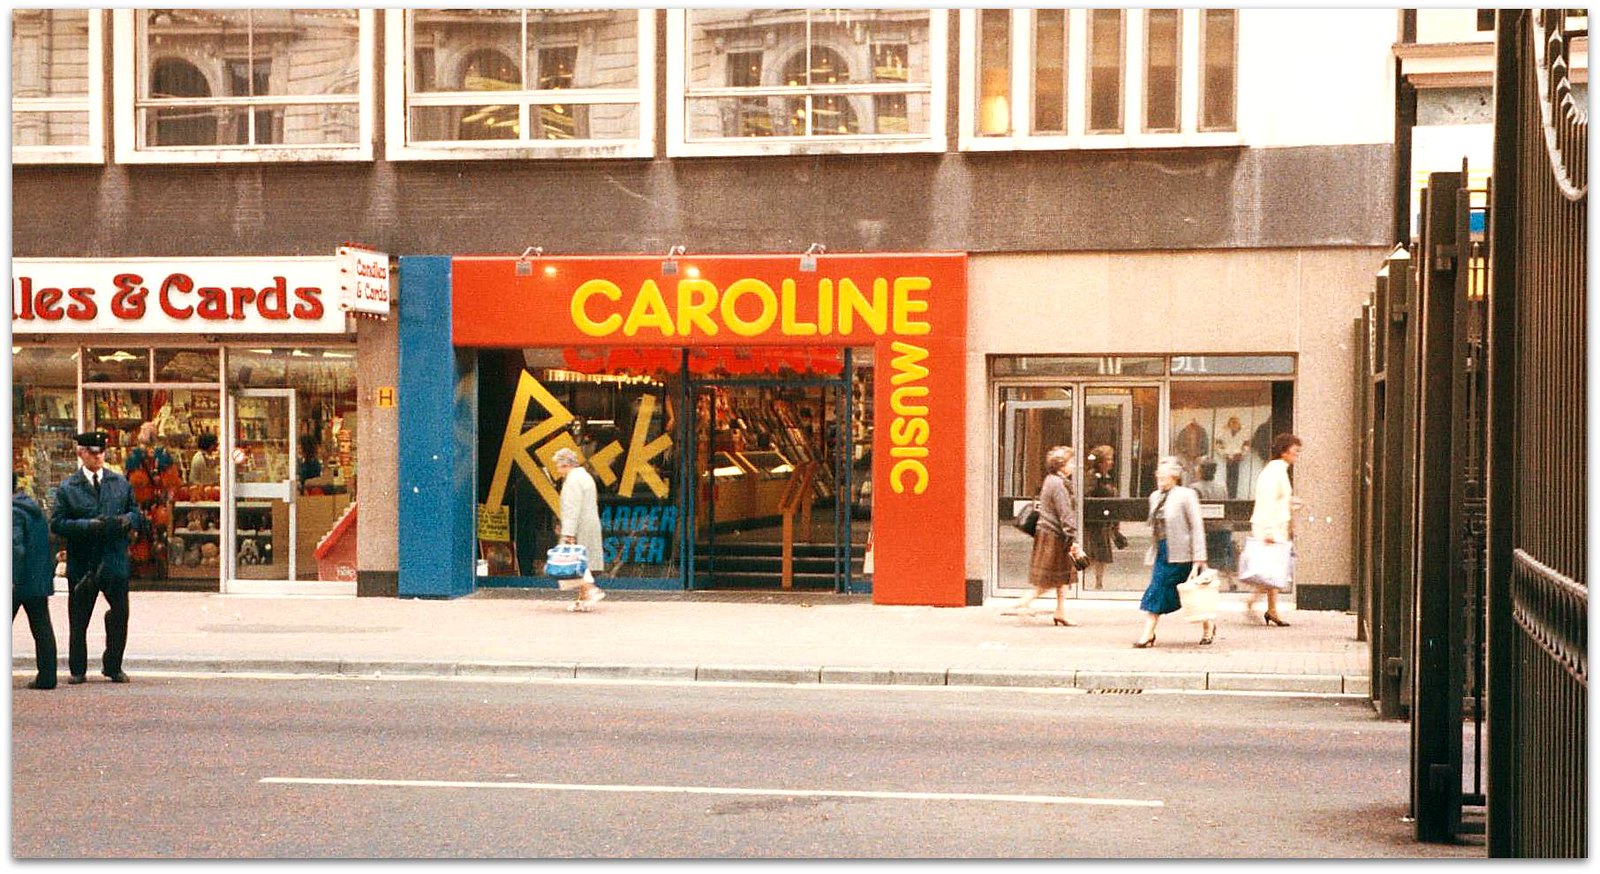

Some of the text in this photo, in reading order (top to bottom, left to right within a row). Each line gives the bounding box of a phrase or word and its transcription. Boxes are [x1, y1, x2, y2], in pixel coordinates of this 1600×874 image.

[356, 259, 387, 280] Candles
[13, 273, 325, 321] les & Cards
[365, 283, 388, 302] Cards
[570, 276, 932, 337] CAROLINE
[379, 389, 393, 406] H
[890, 340, 930, 495] MUSIC
[600, 505, 678, 532] ARDER
[602, 536, 665, 563] STER
